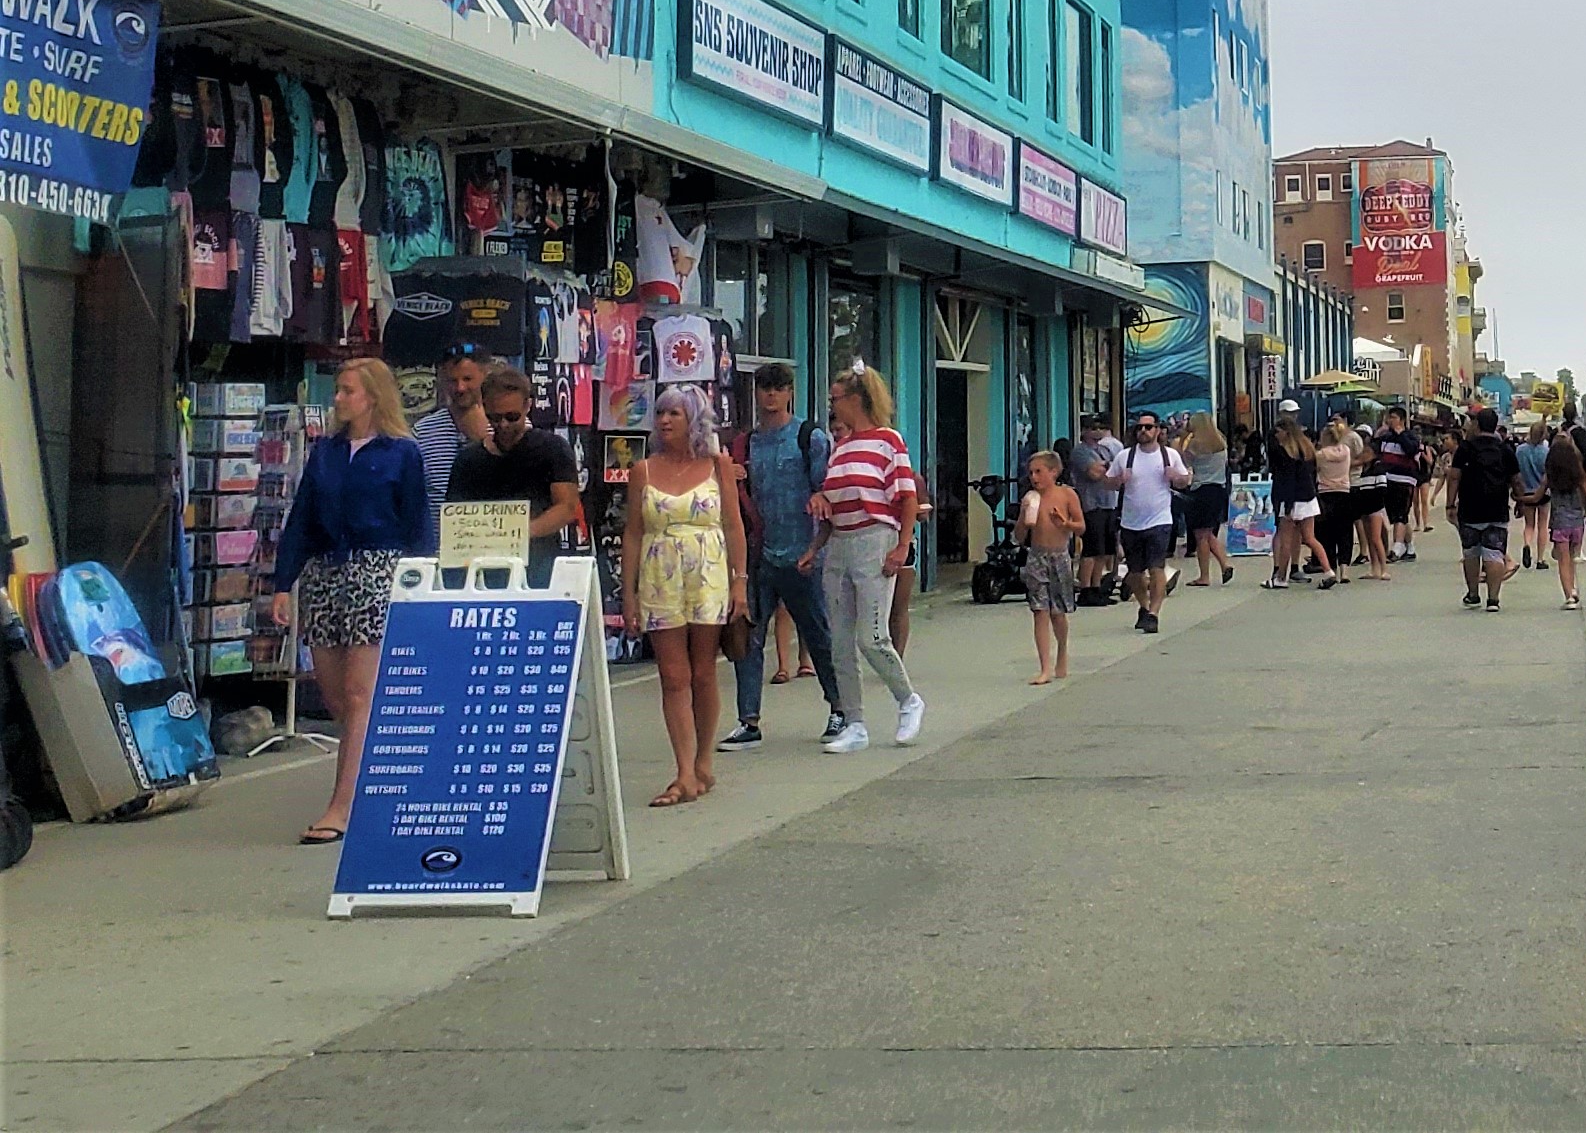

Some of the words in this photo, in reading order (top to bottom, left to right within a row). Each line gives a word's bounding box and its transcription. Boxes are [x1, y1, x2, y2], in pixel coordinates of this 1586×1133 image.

[43, 40, 103, 83] SURF
[726, 13, 789, 84] SOUVENIR
[792, 46, 822, 97] SHOP
[3, 79, 20, 116] &
[0, 128, 53, 168] SALES
[1365, 195, 1393, 211] DEEP
[1401, 193, 1430, 209] EDDY
[1367, 215, 1398, 224] RUBY
[1364, 234, 1433, 252] VODKA
[1375, 273, 1423, 283] GRAPEFRUIT
[1266, 357, 1276, 397] MARKET
[443, 505, 479, 516] COLD
[483, 504, 527, 515] DRINKS
[450, 607, 517, 628] RATES
